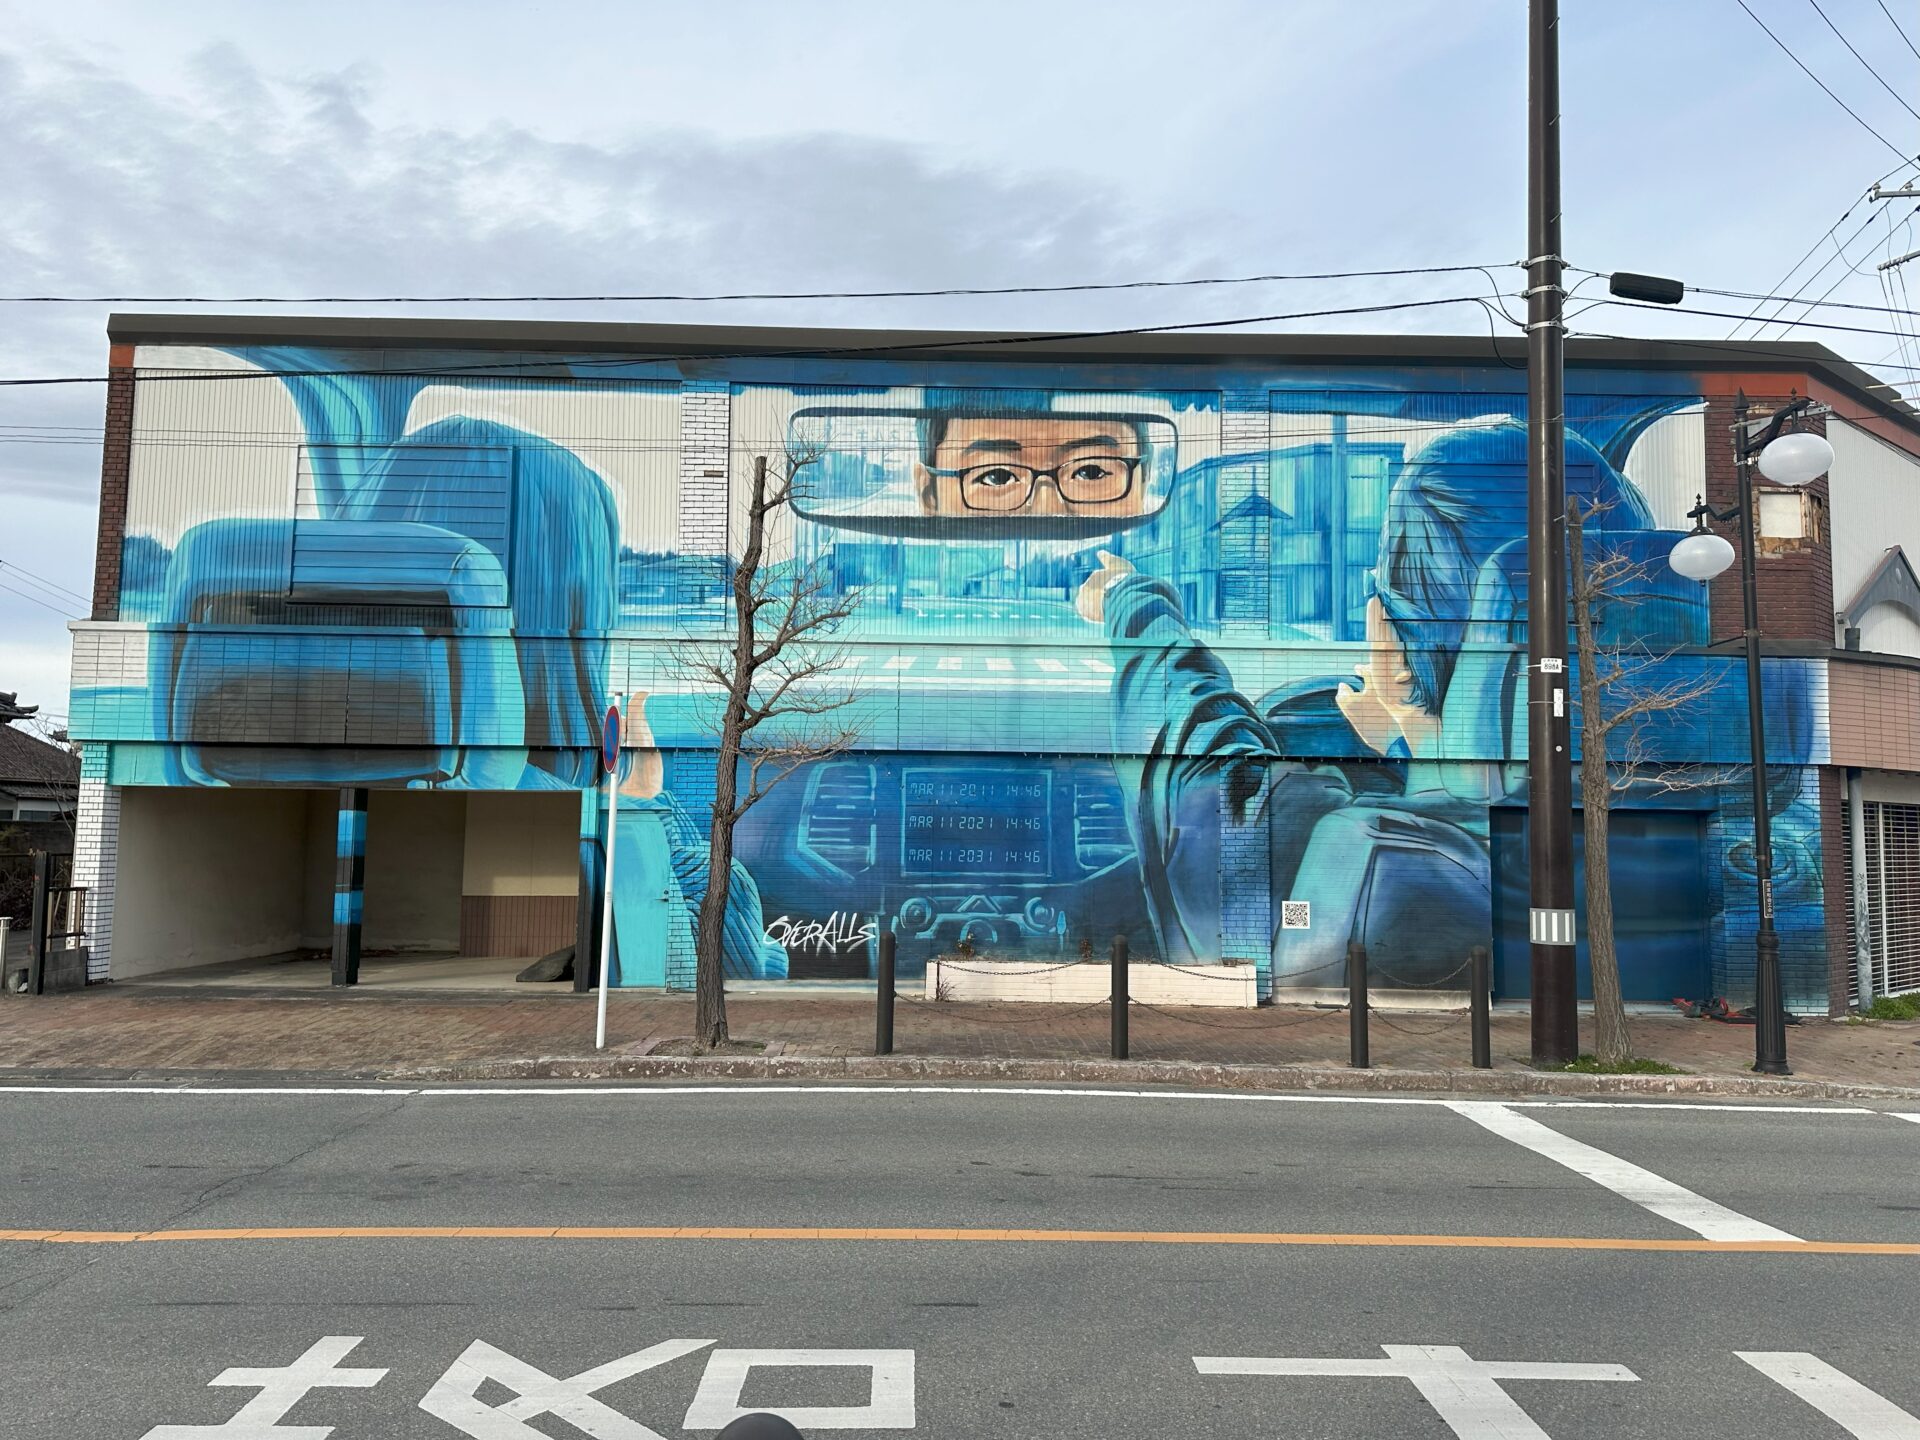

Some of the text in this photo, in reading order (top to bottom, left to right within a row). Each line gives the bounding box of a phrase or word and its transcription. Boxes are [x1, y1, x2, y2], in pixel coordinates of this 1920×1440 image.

[910, 783, 1041, 797] MAR 11 2011 14:46
[909, 816, 1041, 830] MAR 11 2021 14:46
[908, 849, 1040, 863] MAR 11 2031 14:46
